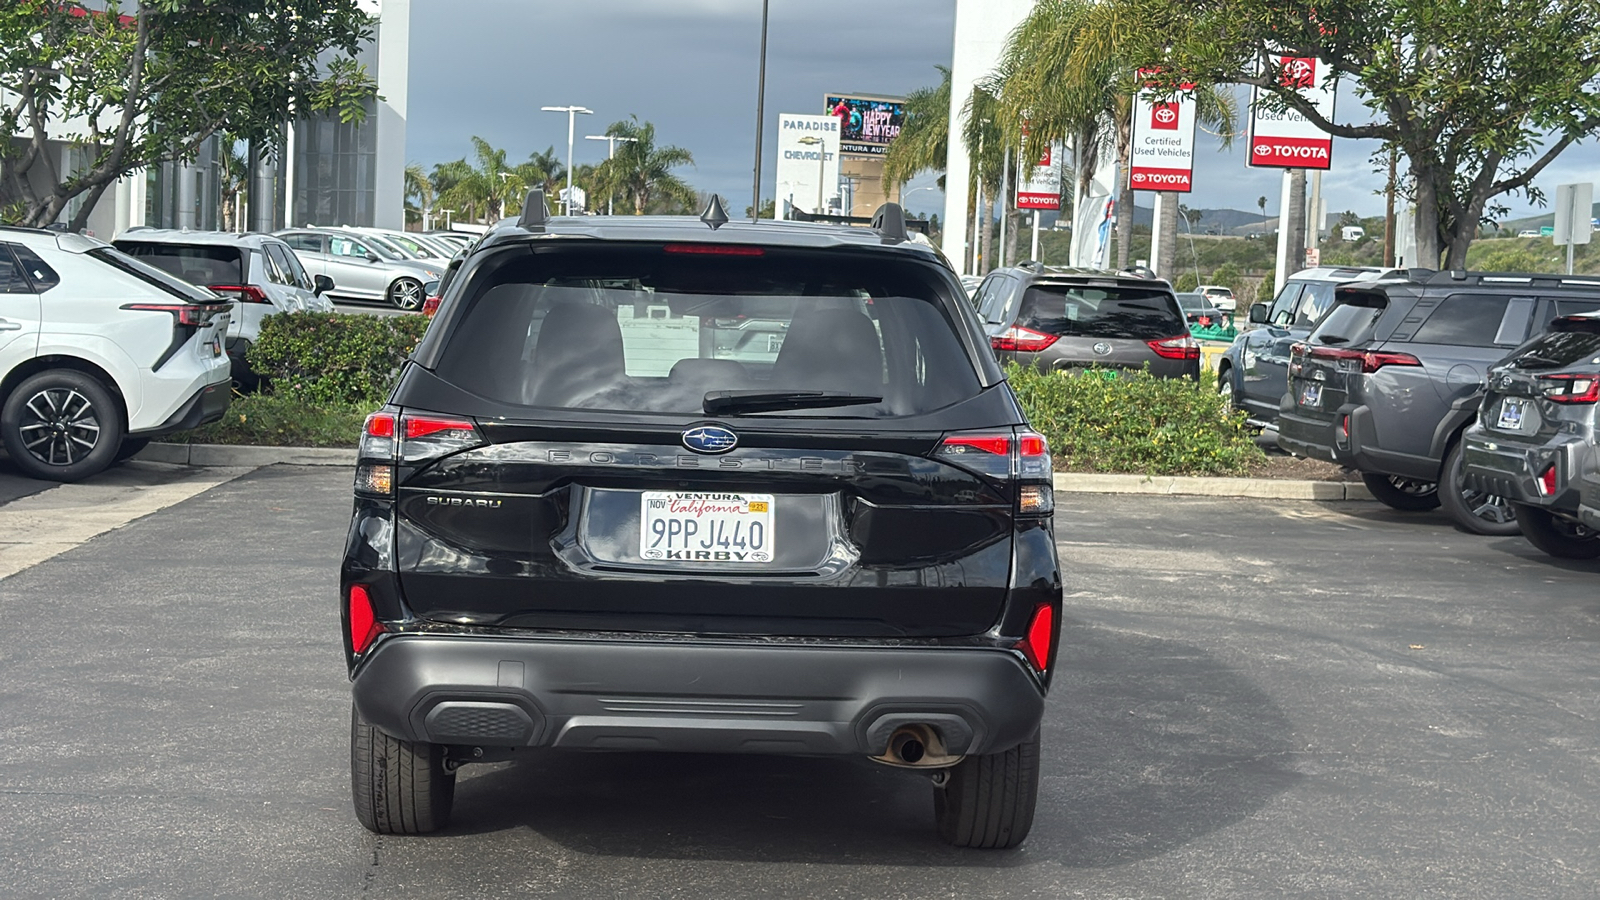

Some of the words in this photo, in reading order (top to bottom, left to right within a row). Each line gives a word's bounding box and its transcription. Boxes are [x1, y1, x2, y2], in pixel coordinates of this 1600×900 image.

[863, 110, 892, 126] HAPPY
[783, 120, 837, 131] PARADISE
[862, 124, 880, 136] NEW
[881, 125, 900, 138] YEAR
[1145, 137, 1181, 146] Certified
[1134, 147, 1155, 155] Used
[1157, 148, 1191, 157] Vehicles
[1273, 145, 1328, 159] TOYOTA
[1147, 173, 1189, 184] TOYOTA
[1029, 196, 1059, 205] TOYOTA
[547, 449, 867, 473] FORESTER
[427, 496, 502, 508] SUBARU
[675, 493, 741, 501] VENTURA
[650, 500, 666, 509] NOV
[670, 499, 749, 518] California
[650, 518, 764, 551] 9PPJ440
[666, 550, 749, 561] KIRBY
